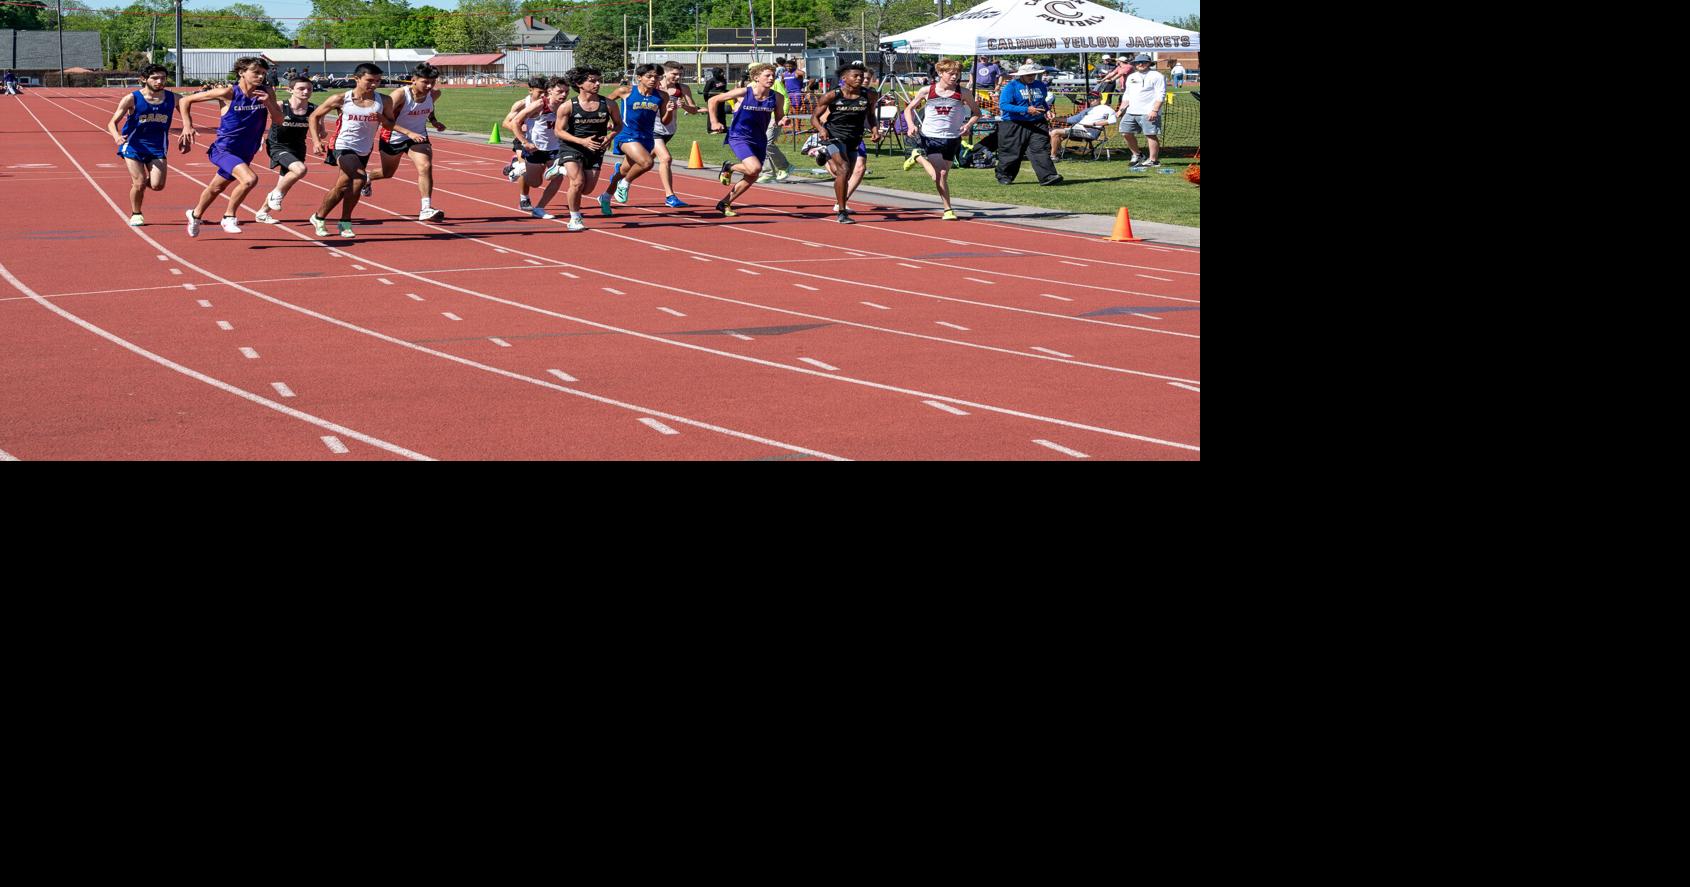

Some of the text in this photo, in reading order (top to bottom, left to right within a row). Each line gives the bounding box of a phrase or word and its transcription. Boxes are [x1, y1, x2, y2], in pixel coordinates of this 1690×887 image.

[1036, 13, 1105, 27] FOOTBALL
[987, 35, 1191, 50] CALHOUN YELLOW JACKETS
